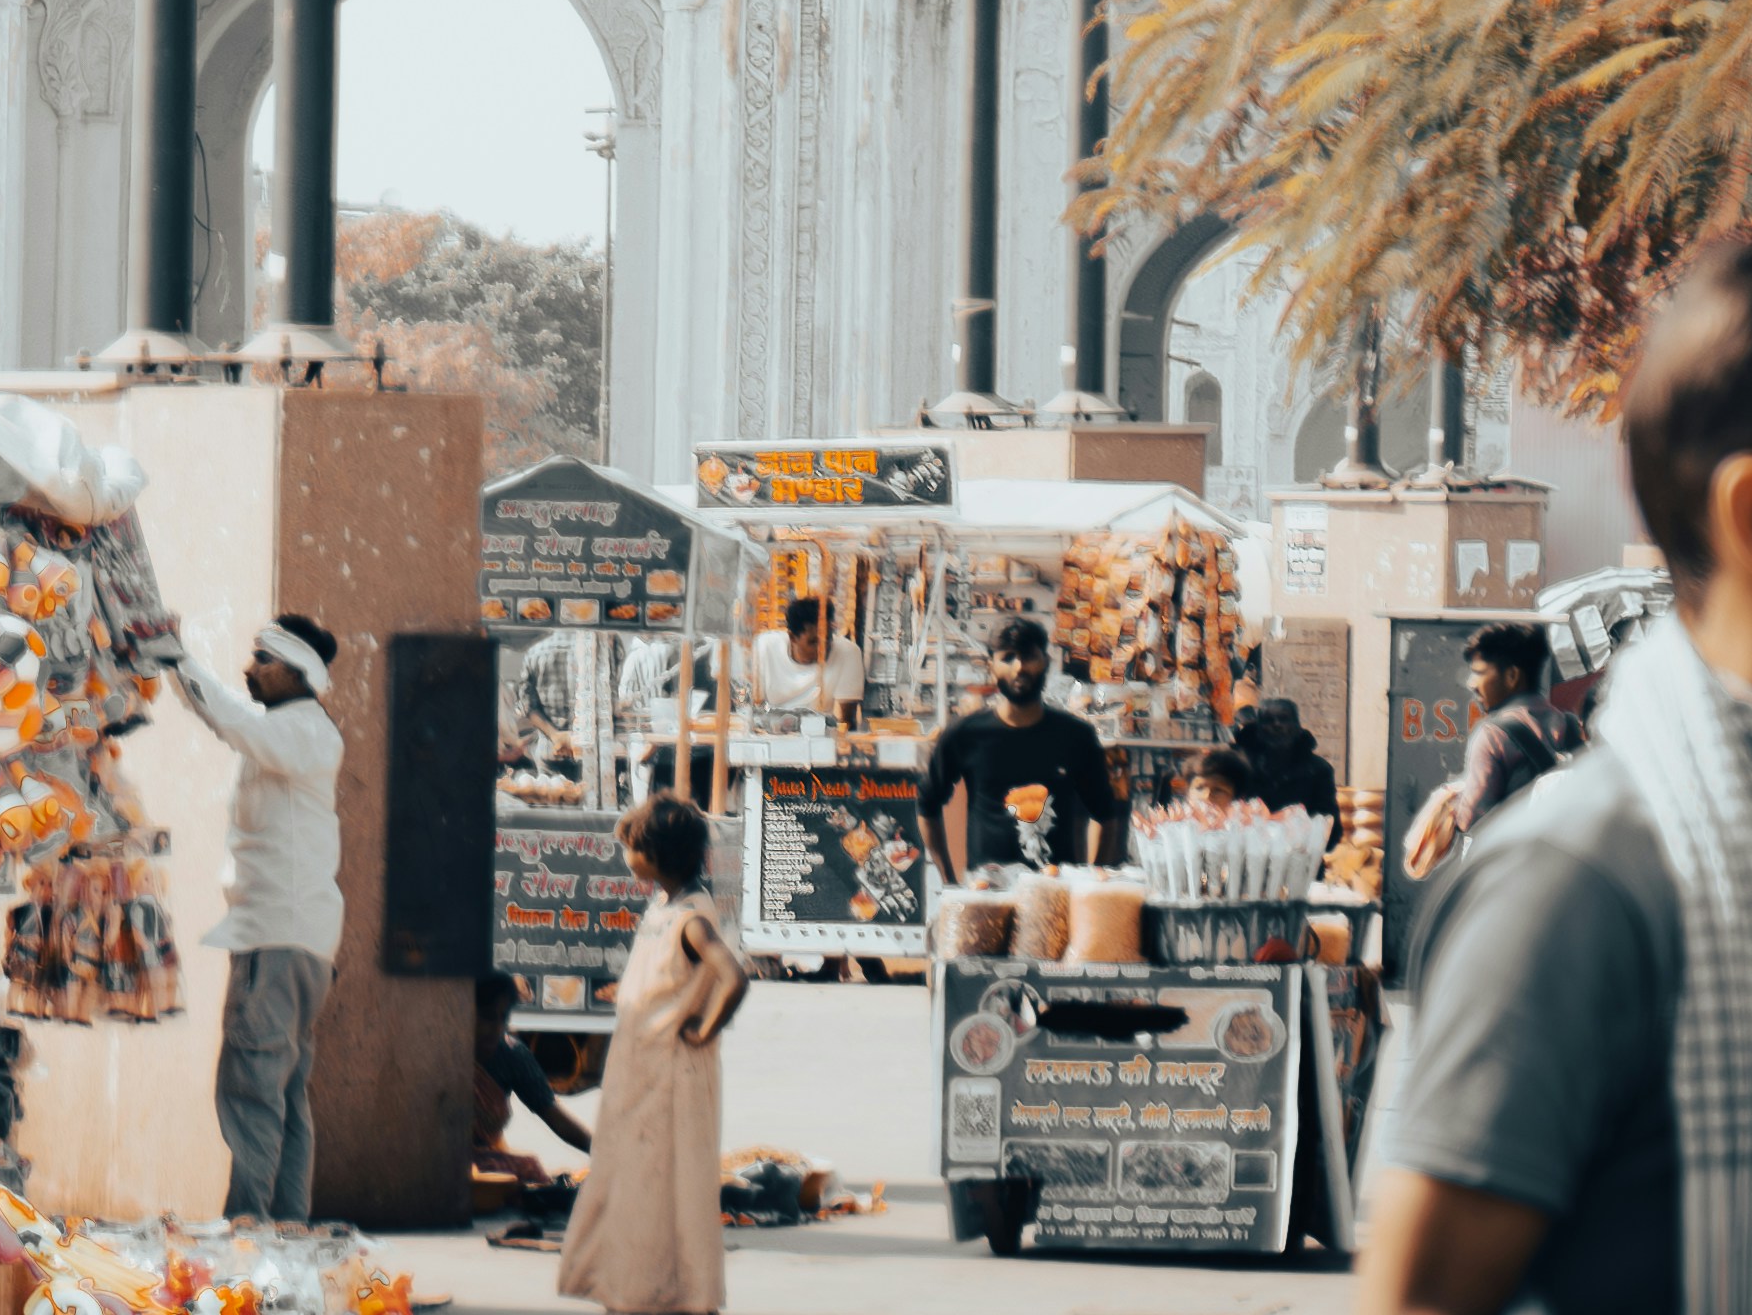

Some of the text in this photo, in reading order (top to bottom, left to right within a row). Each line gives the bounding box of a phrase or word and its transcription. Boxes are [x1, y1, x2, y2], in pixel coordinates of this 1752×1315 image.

[755, 450, 879, 476] जान पान
[771, 477, 864, 503] भण्डार
